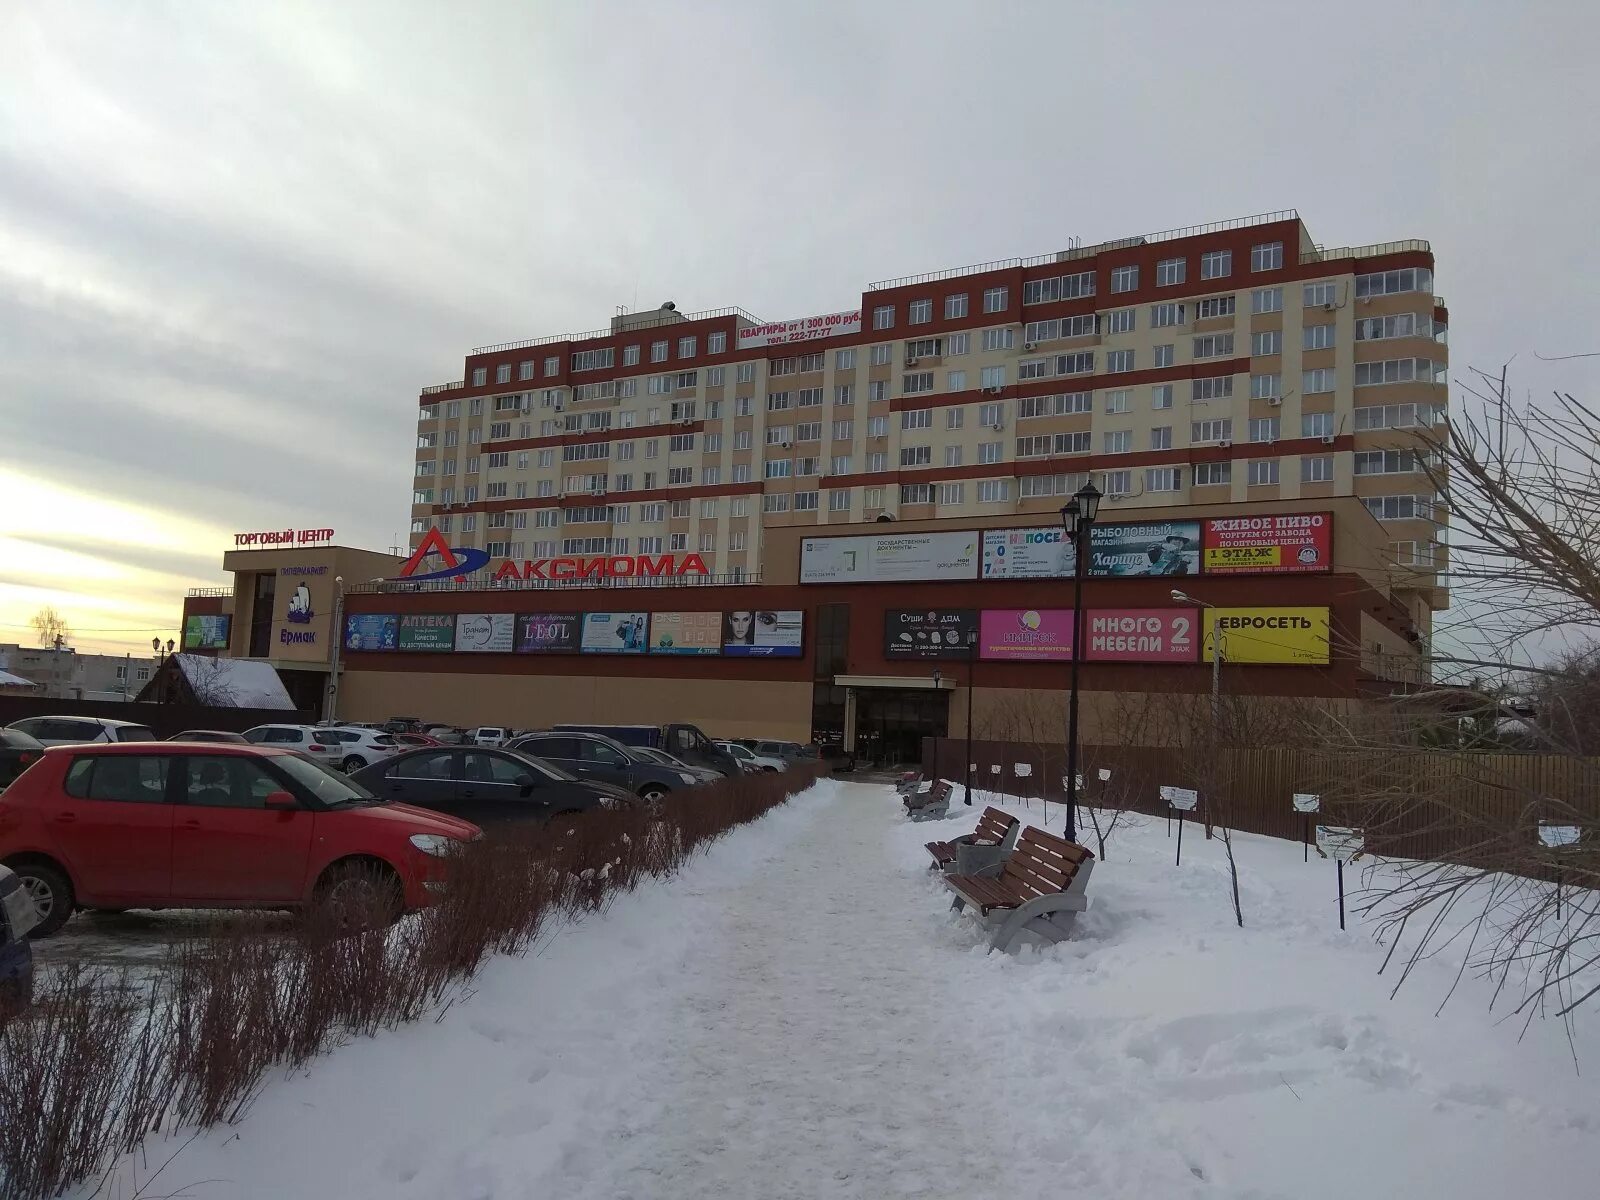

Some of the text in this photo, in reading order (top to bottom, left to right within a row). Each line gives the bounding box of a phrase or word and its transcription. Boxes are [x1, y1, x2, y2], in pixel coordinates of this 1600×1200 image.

[740, 312, 862, 339] КВАРТИРЫ от 1 300 000 руб.
[789, 328, 832, 342] 222-77-77
[1211, 515, 1323, 532] ЖИВОЕ ПИВО
[234, 528, 335, 546] ТОРГОВЫЙ ЦЕНТР
[1090, 524, 1172, 538] РЫБОЛОВНЫЙ
[1220, 529, 1312, 542] ТОРГУЕМ ОТ ЗАВОДА
[877, 538, 931, 546] ГОСУДАРСТВЕННЫЕ
[1220, 537, 1315, 550] ПО ОПТОВЫМ ЦЕНАМ
[1211, 548, 1273, 558] 1 ЭТАЖ
[495, 554, 710, 580] АКСИОМА
[1092, 552, 1144, 569] Хариус
[984, 563, 992, 574] 7
[401, 615, 453, 627] АПТЕКА
[654, 613, 680, 623] DNS
[1093, 617, 1162, 633] МНОГО
[1220, 616, 1312, 629] ЕВРОСЕТЬ
[280, 629, 316, 645] Ермак
[524, 623, 570, 640] LEOL
[1171, 617, 1191, 644] 2
[1092, 635, 1162, 652] МЕБЕЛИ
[1170, 645, 1191, 653] ЭТАЖ
